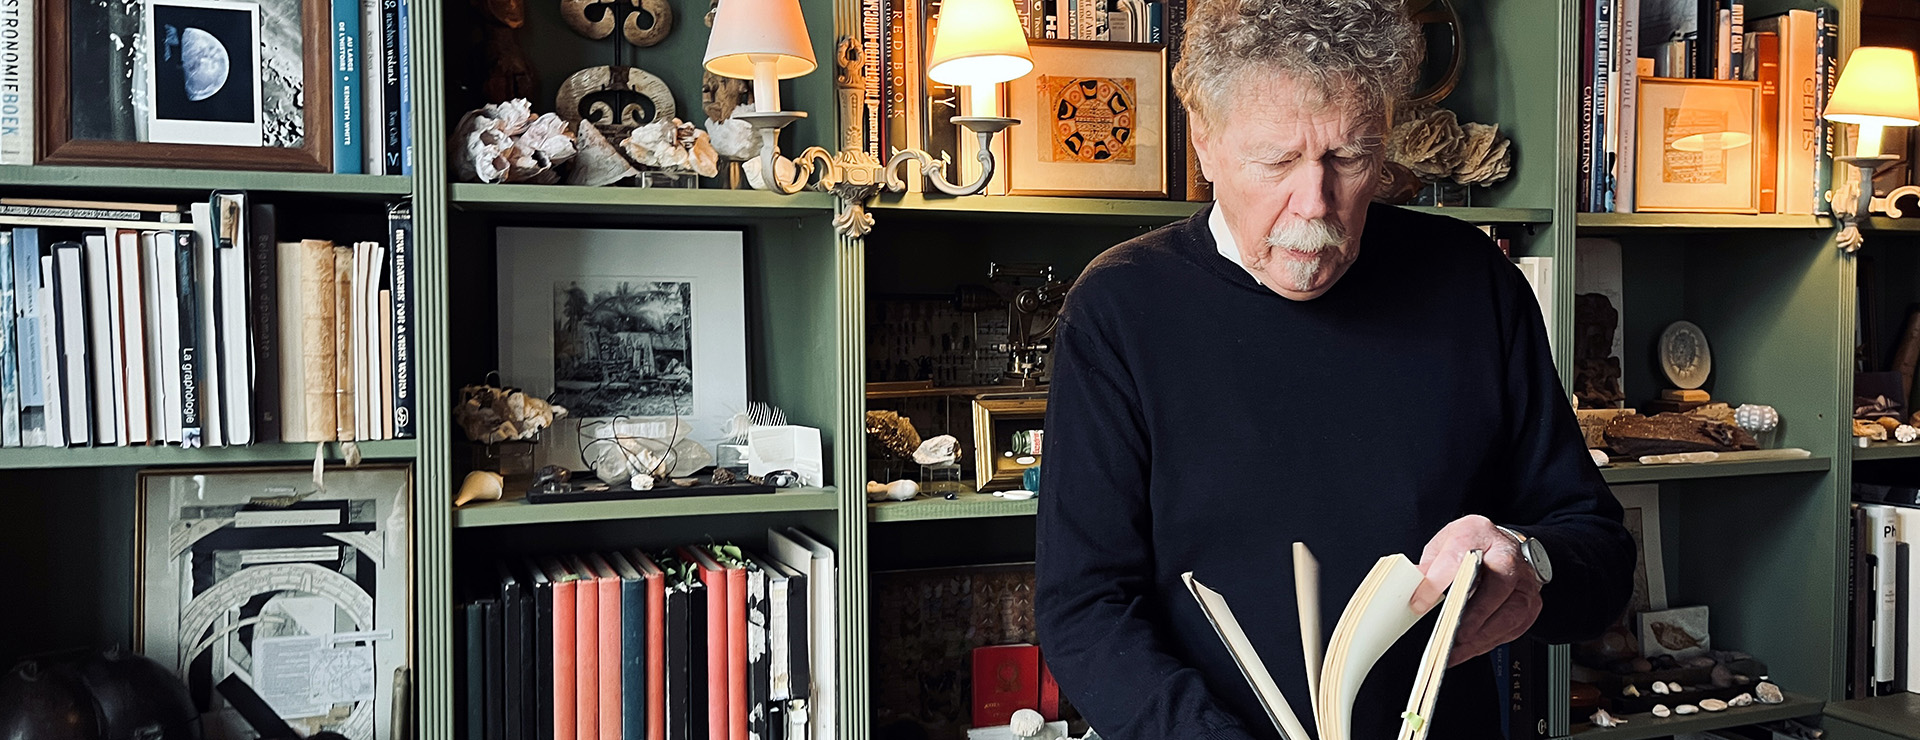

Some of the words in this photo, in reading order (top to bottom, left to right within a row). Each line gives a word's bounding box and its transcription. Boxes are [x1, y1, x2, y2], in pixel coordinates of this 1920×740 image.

[339, 22, 346, 31] DE
[892, 10, 904, 51] RED
[1085, 10, 1094, 21] of
[347, 36, 354, 47] AU
[1624, 20, 1633, 65] ULTIMA
[887, 86, 893, 96] TO
[893, 61, 905, 119] BOOK
[1582, 86, 1592, 121] CARLO
[1582, 124, 1591, 173] MOLLINO
[257, 234, 270, 290] Belgische
[259, 294, 272, 360] diplomaten
[182, 348, 194, 361] La
[179, 364, 196, 424] graphologie
